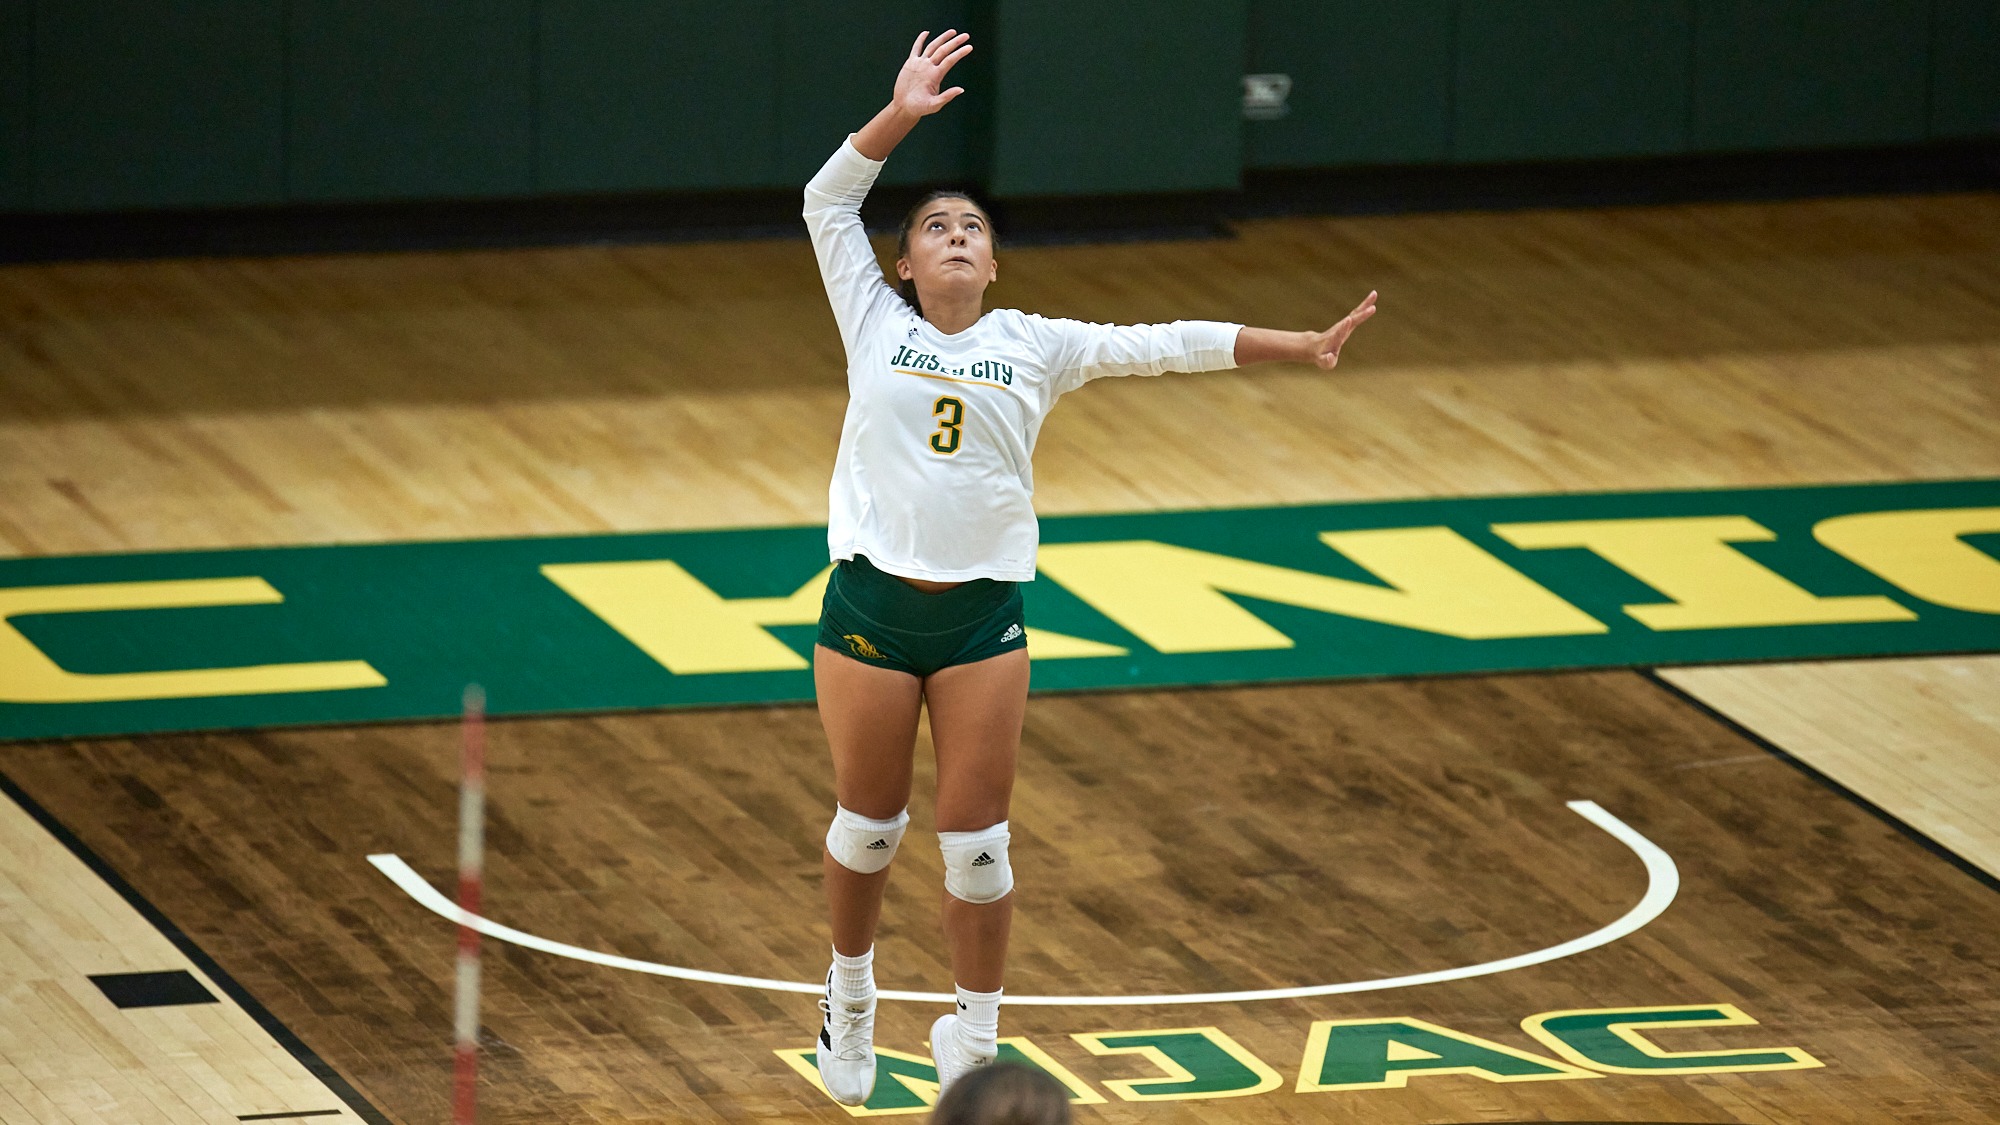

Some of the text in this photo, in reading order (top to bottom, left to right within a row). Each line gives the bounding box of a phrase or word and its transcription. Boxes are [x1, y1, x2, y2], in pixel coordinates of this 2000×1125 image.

[971, 360, 1013, 386] CITY
[928, 394, 966, 456] 3
[971, 858, 996, 867] adidas
[773, 1003, 1826, 1118] NJAC
